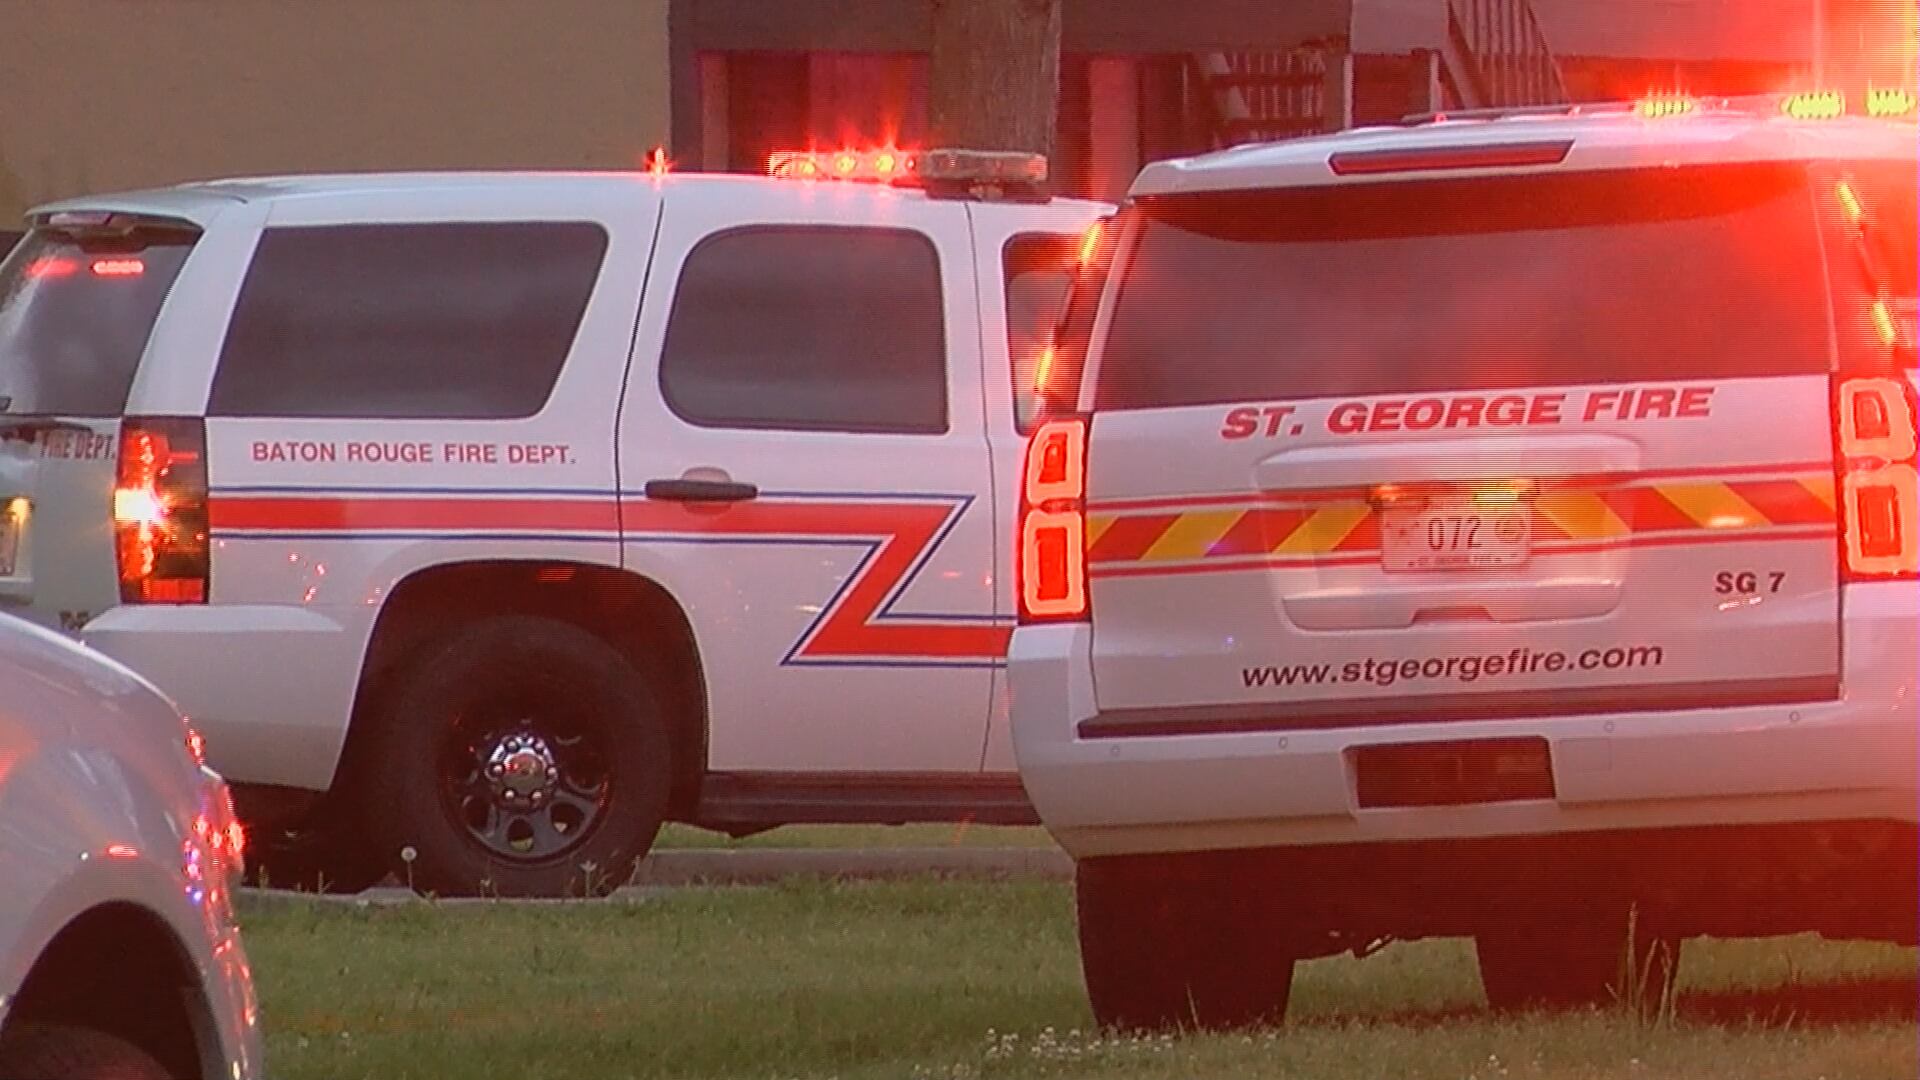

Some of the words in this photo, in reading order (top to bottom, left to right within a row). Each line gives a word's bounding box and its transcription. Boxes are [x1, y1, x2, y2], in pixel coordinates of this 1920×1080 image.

[1220, 405, 1304, 440] ST.
[1326, 393, 1567, 435] GEORGE
[1582, 387, 1715, 422] FIRE
[252, 441, 337, 463] BATON
[346, 441, 433, 463] ROUGE
[443, 443, 498, 464] FIRE
[507, 444, 577, 465] DEPT.
[1427, 516, 1483, 551] 072
[1714, 570, 1757, 595] SG
[1768, 571, 1786, 594] 7
[1242, 645, 1663, 687] www.stgeorgefire.com
